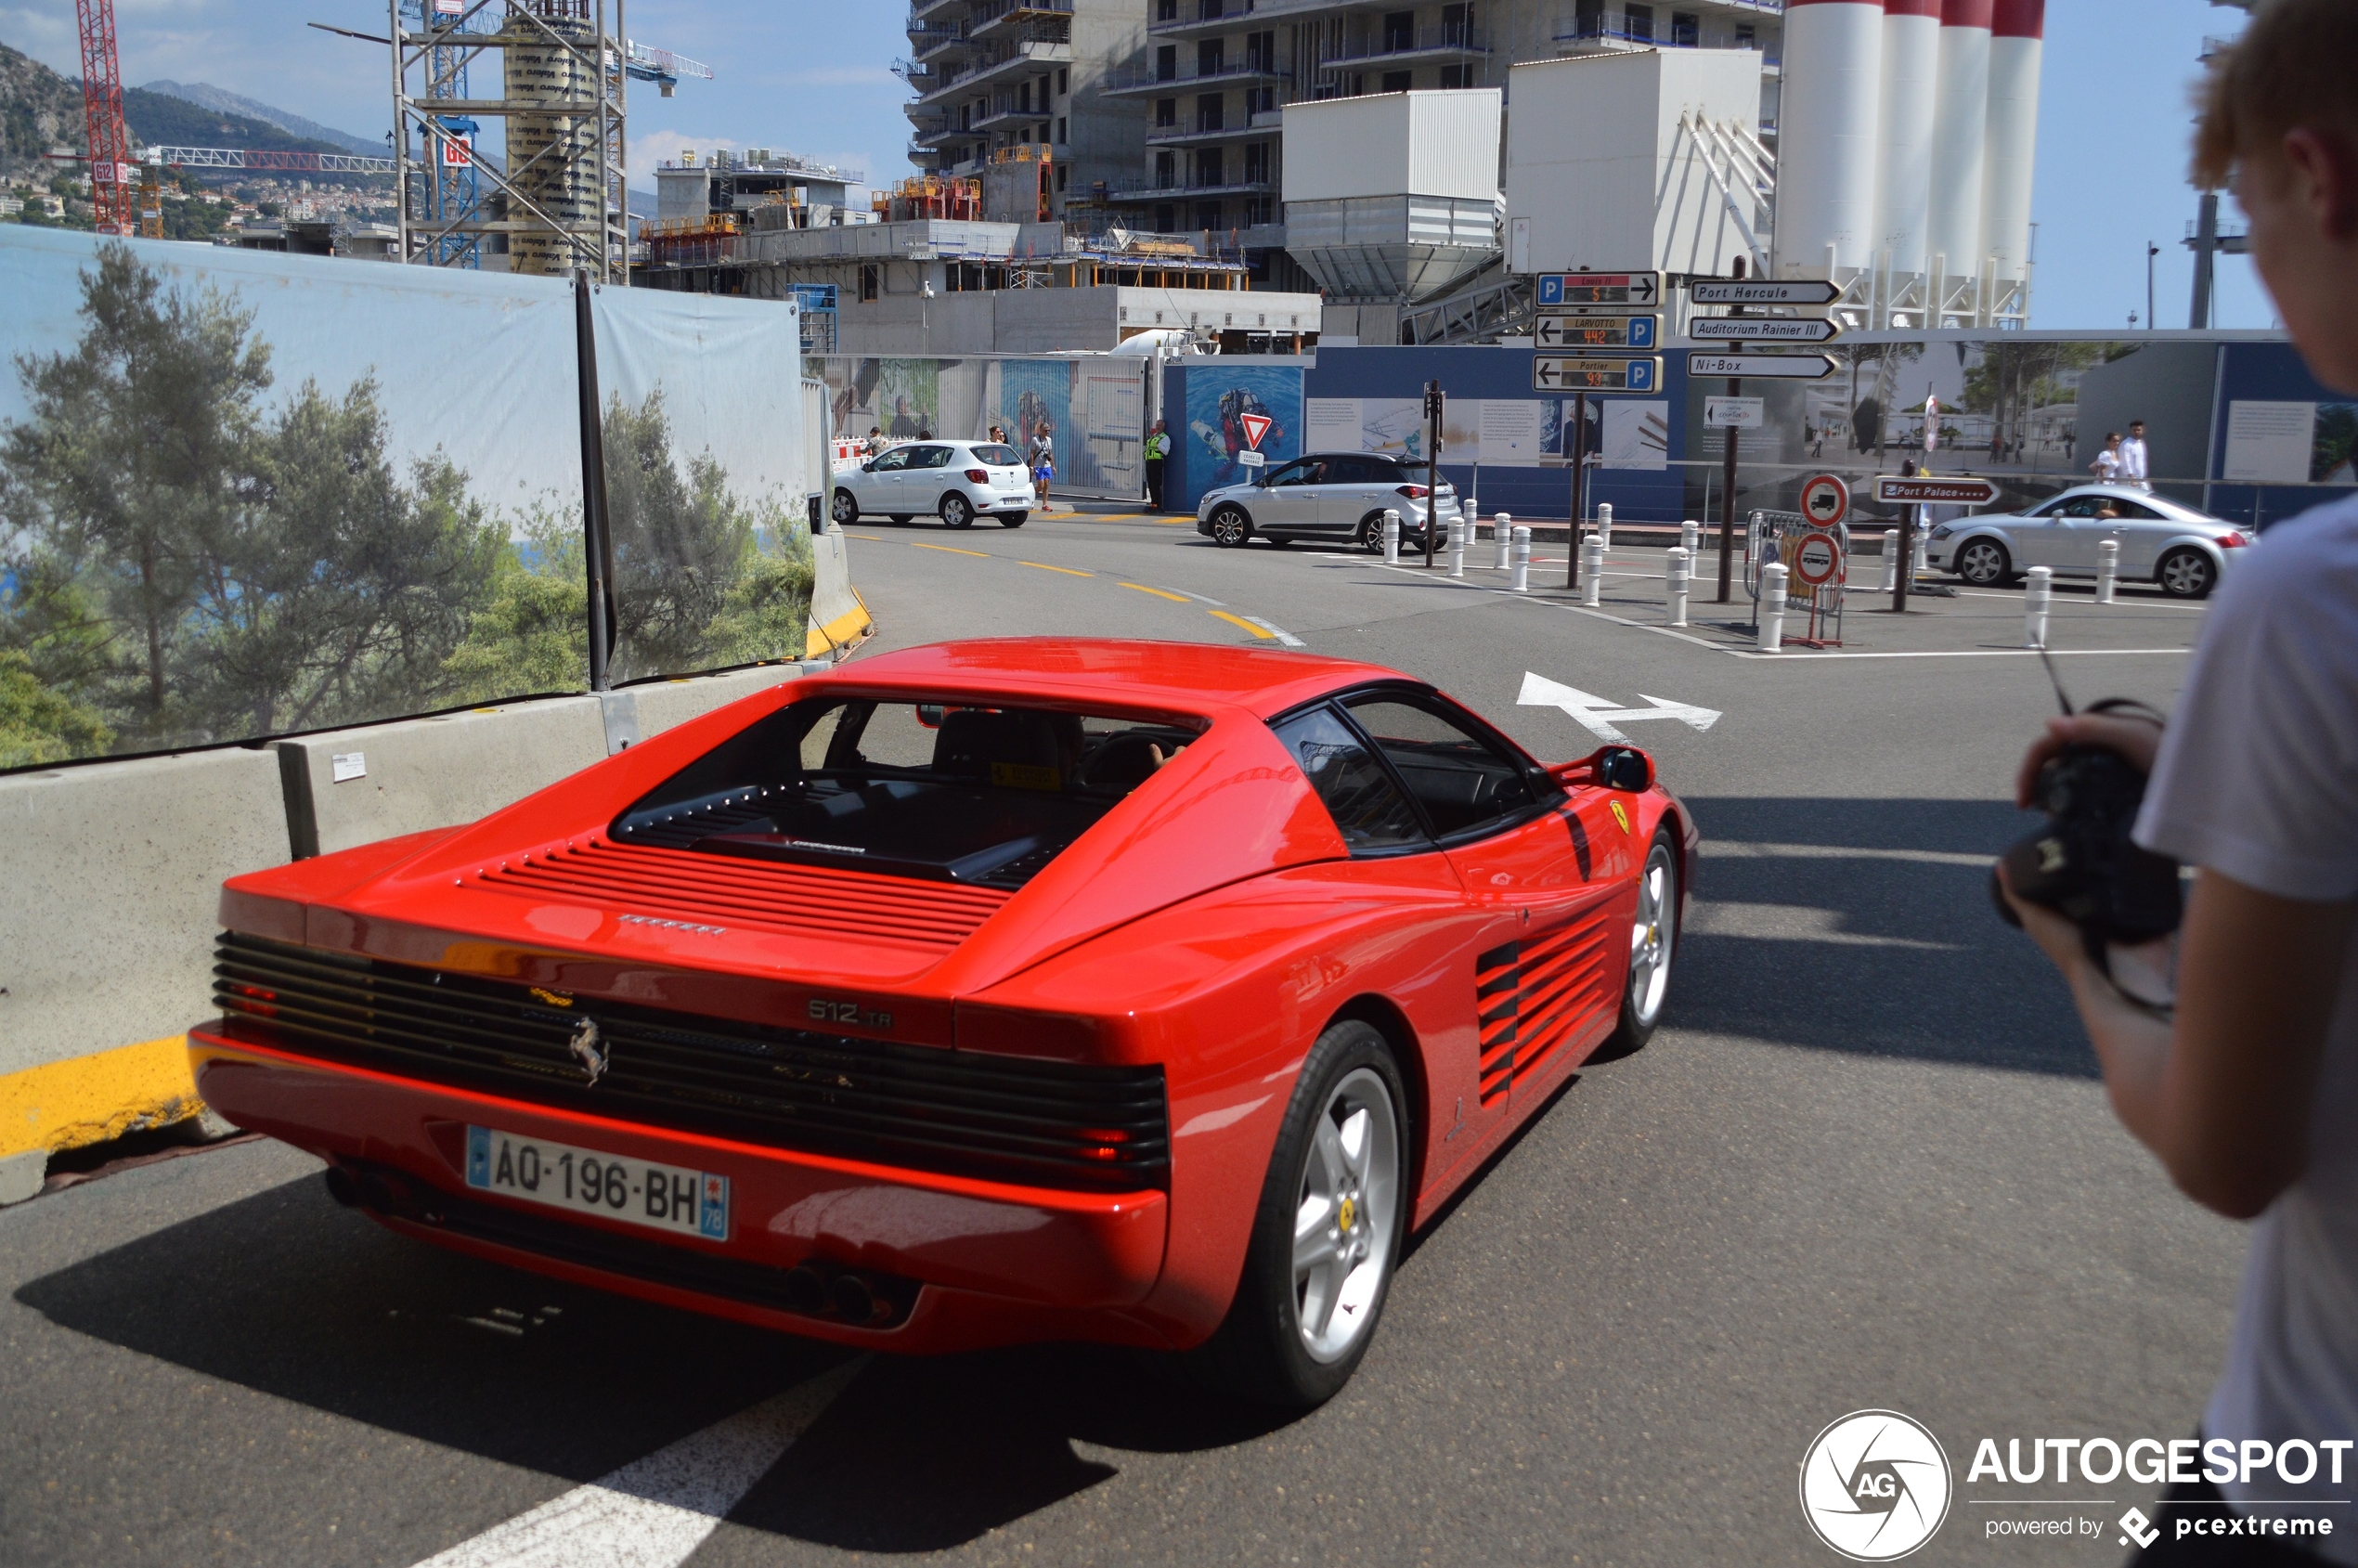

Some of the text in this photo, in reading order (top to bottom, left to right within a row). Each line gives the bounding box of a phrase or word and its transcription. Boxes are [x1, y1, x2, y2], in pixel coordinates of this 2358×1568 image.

[515, 55, 576, 67] Valero Valero
[526, 70, 555, 78] Valero
[562, 71, 586, 83] Valero
[539, 84, 569, 95] Valero
[516, 127, 541, 136] Valero
[96, 163, 112, 179] G12
[567, 184, 591, 195] Valero
[546, 196, 575, 206] Valero
[560, 211, 586, 221] Valero
[521, 238, 546, 247] Valero
[532, 252, 560, 261] Valero
[1581, 277, 1602, 286] Louis
[1592, 287, 1600, 302] 5
[1698, 287, 1788, 299] Port Hercule
[1574, 319, 1615, 328] LARVOTTO
[1697, 323, 1819, 336] Auditorium Rainier III
[1584, 330, 1606, 344] 442
[1580, 361, 1608, 370] Portier
[1695, 359, 1742, 371] Ni-Box
[1587, 372, 1602, 386] 93
[1897, 486, 1958, 497] Port Palace
[808, 999, 858, 1022] 512
[704, 1208, 723, 1230] 78
